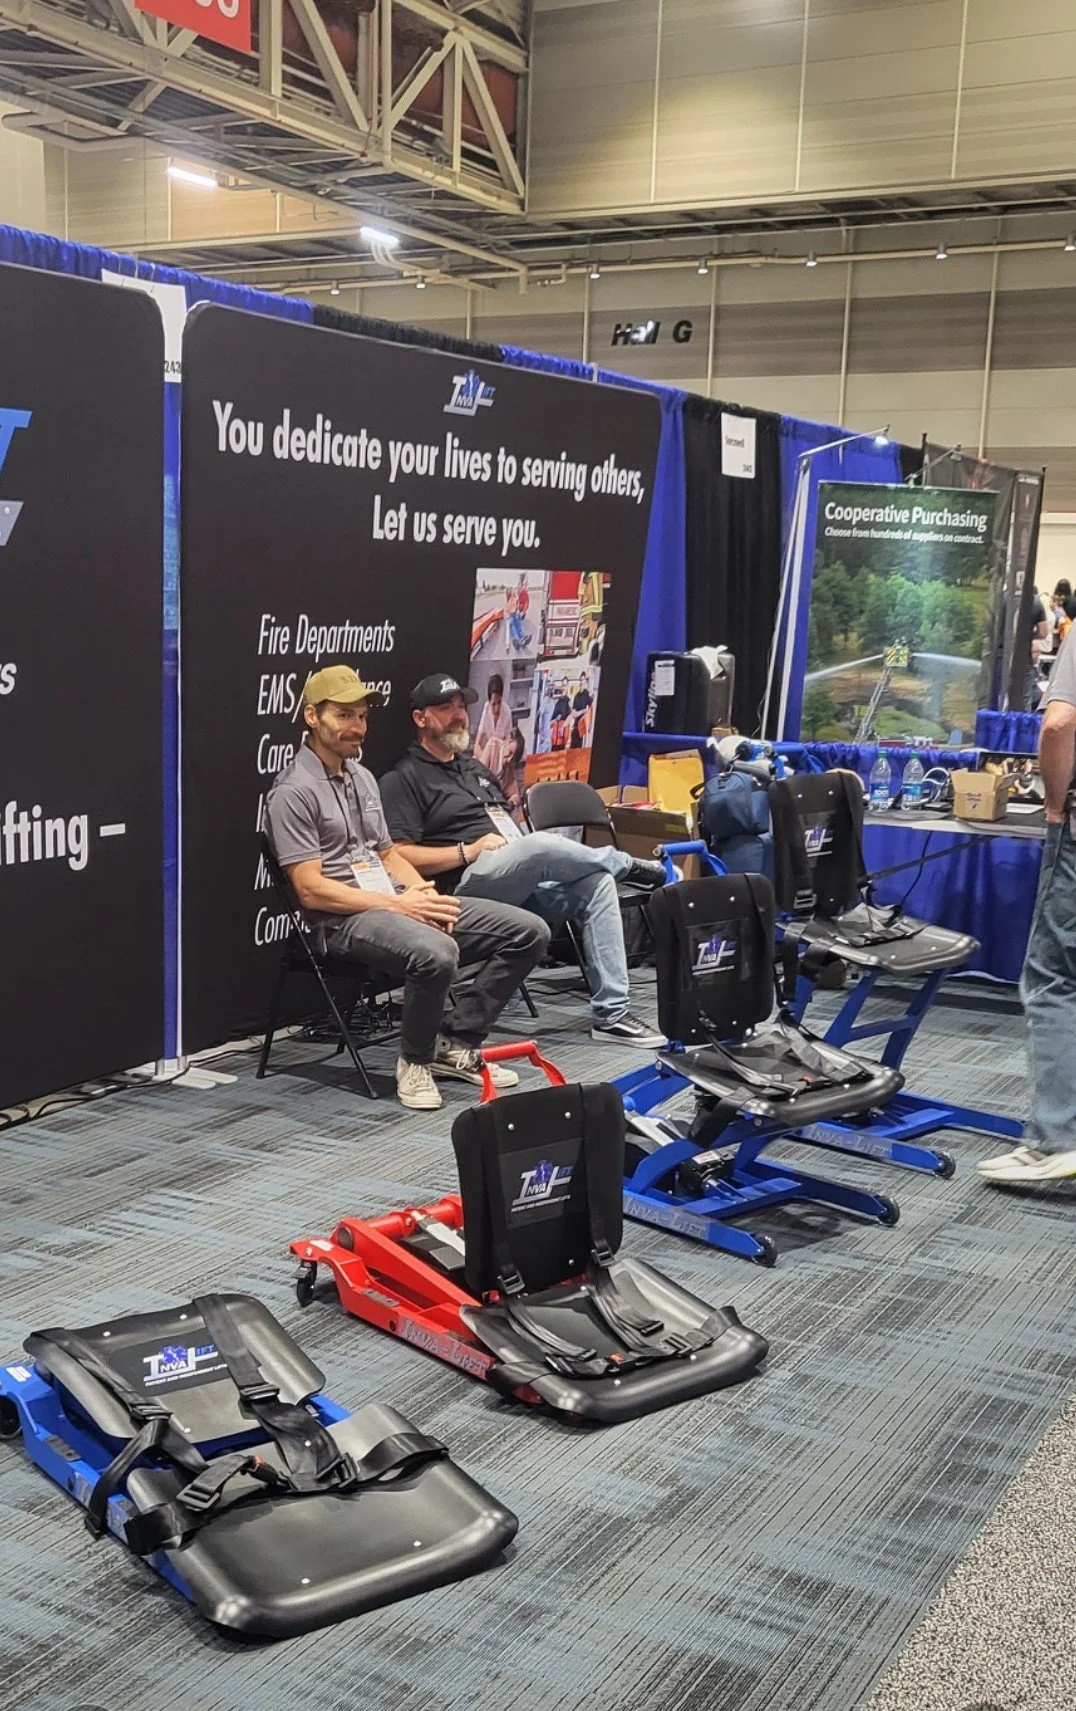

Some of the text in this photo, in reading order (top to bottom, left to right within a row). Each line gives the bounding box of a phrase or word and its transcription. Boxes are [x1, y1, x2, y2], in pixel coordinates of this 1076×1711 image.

[612, 320, 693, 346] Hall G
[212, 400, 645, 504] You dedicate your lives to serving others,
[372, 494, 540, 557] Let us serve you.
[824, 526, 851, 537] Choose
[852, 527, 870, 538] from
[870, 528, 903, 539] hundreds
[902, 529, 912, 540] of
[912, 531, 943, 543] suppliers
[944, 534, 954, 542] on
[825, 501, 988, 532] Cooperative Purchasing
[258, 613, 396, 663] Fire Departments
[257, 734, 294, 774] Care
[0, 801, 89, 871] fting
